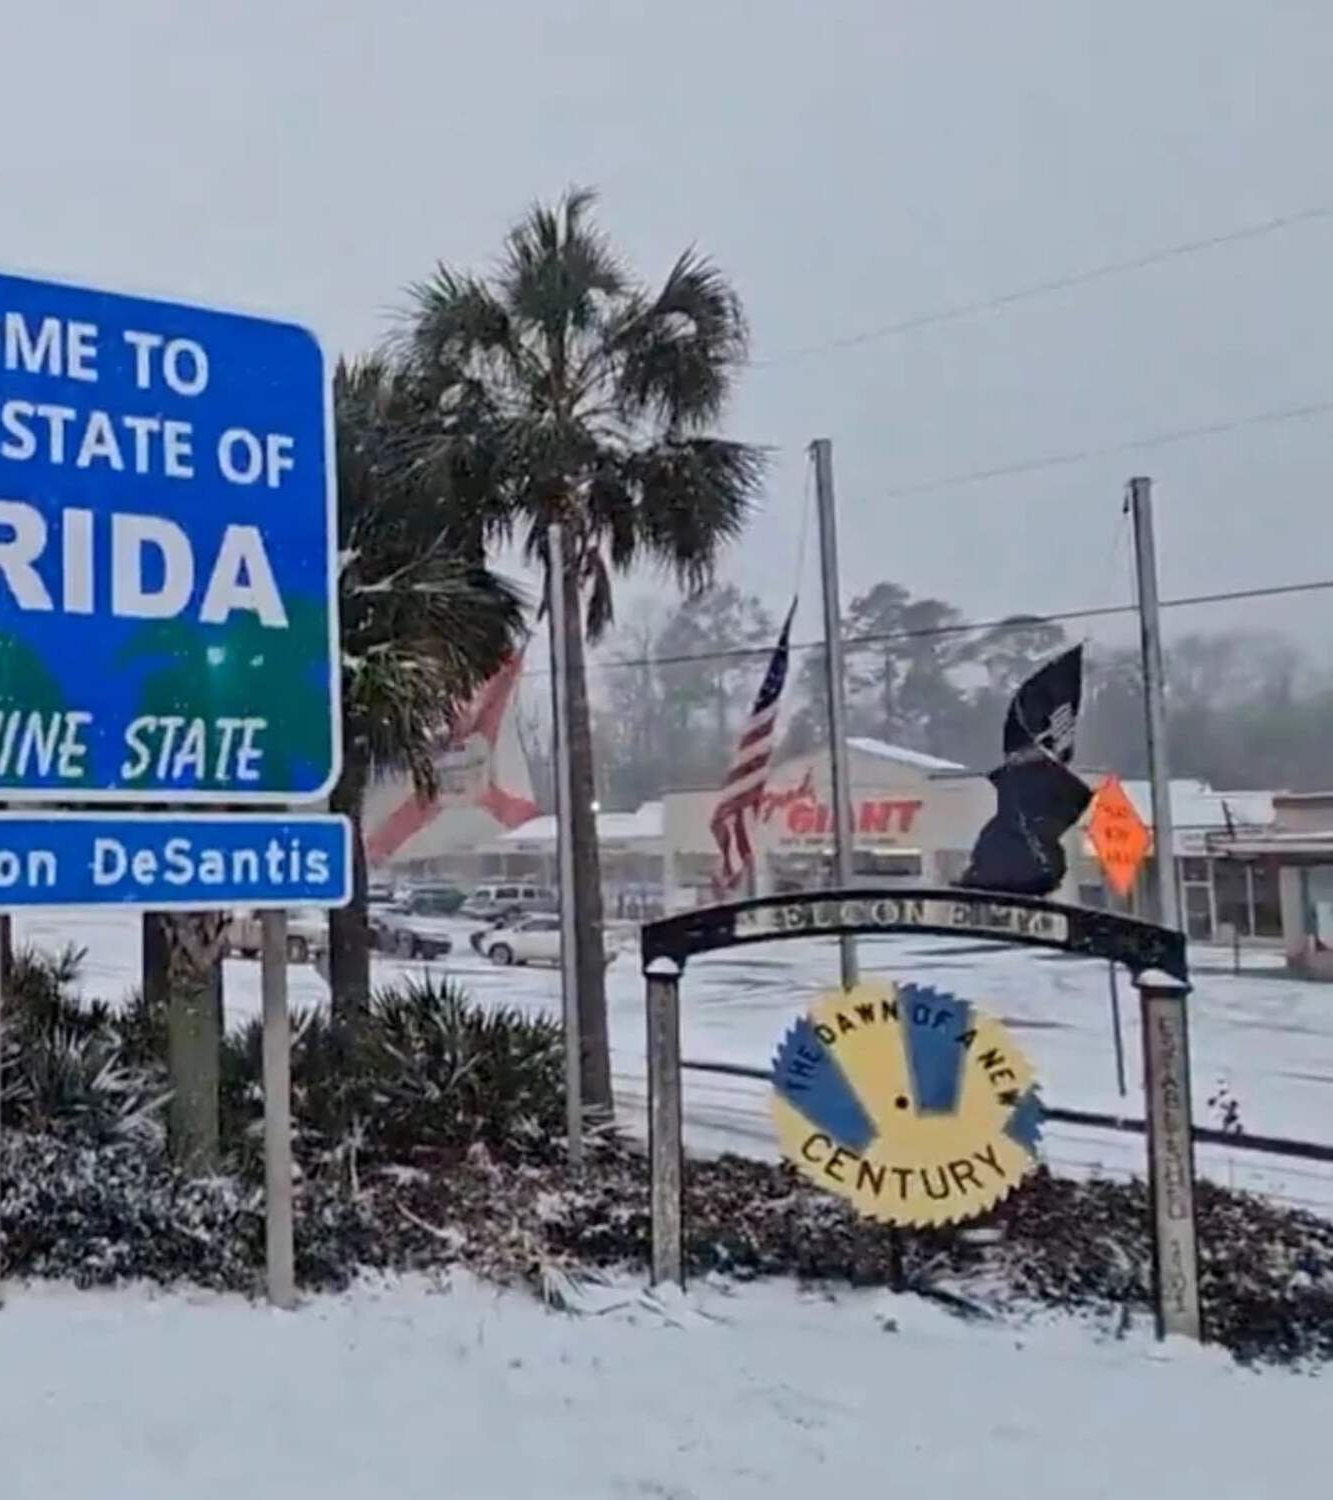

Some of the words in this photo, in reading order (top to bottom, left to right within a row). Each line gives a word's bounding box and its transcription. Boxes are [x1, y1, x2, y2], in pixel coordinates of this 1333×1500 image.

[124, 330, 209, 397] TO
[1, 400, 194, 478] STATE
[218, 427, 295, 489] OF
[121, 715, 267, 782] STATE
[92, 836, 330, 888] DeSantis
[786, 1046, 822, 1091] THE
[814, 1000, 898, 1045] DAWN
[912, 1004, 954, 1029] OF
[955, 1028, 978, 1050] A
[978, 1048, 1020, 1106] NEW
[801, 1133, 1006, 1200] CENTURY
